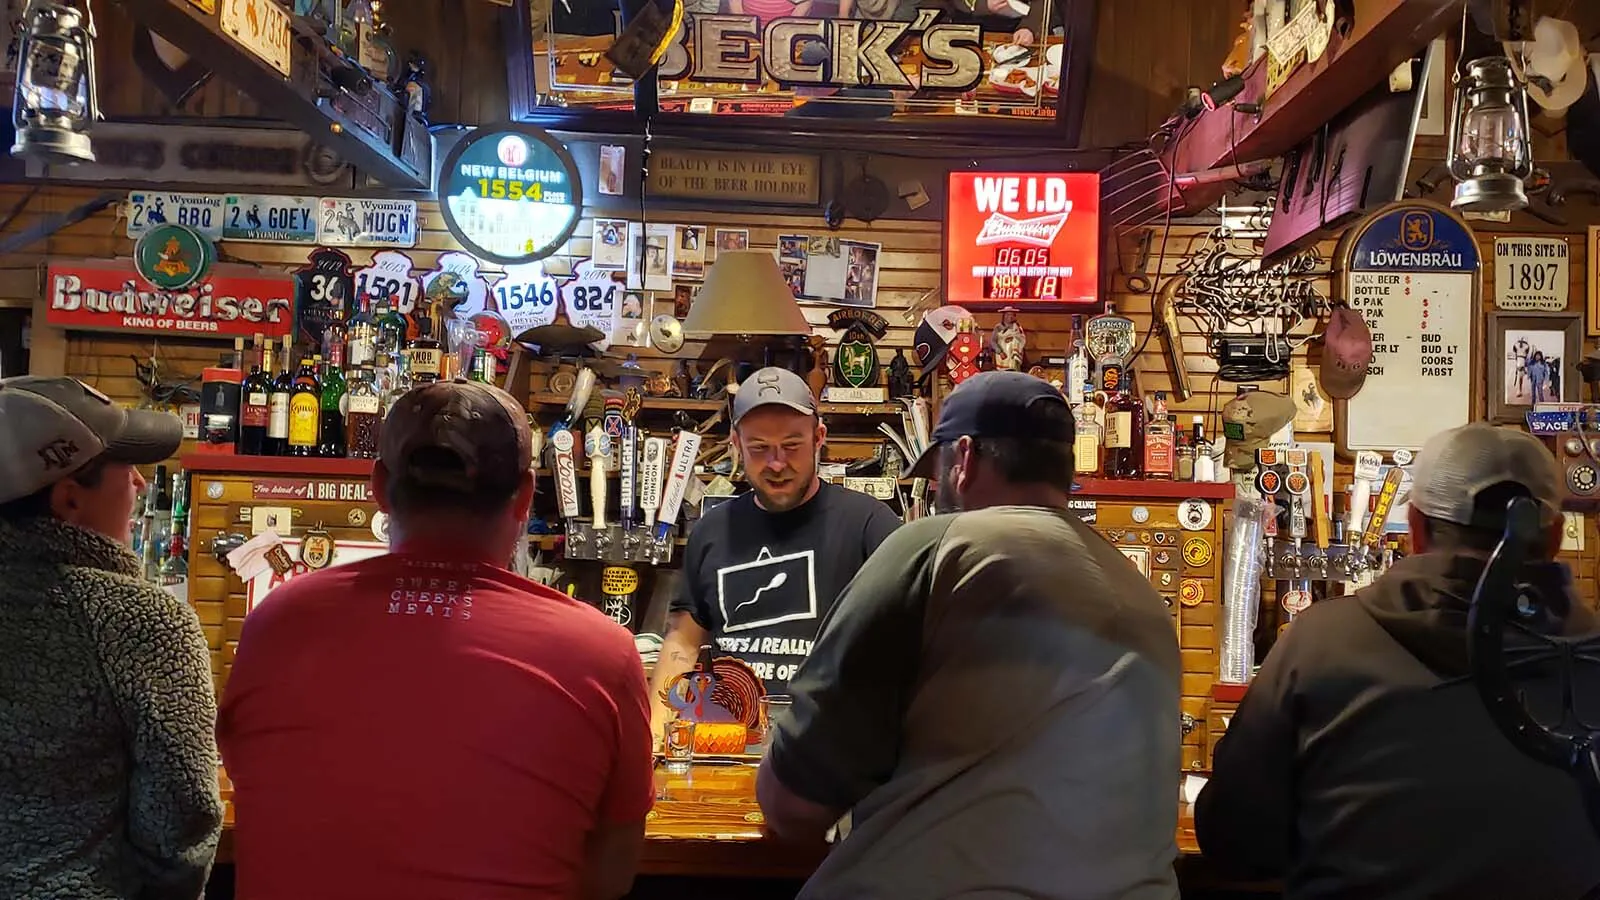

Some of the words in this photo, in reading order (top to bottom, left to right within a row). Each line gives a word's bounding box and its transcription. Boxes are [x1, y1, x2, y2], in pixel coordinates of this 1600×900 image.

[460, 164, 496, 178] NEW
[498, 166, 561, 183] BELGIUM
[661, 156, 711, 171] BEAUTY
[718, 159, 728, 171] IS
[733, 159, 746, 173] IN
[752, 161, 775, 174] THE
[782, 162, 807, 176] EYE
[478, 178, 542, 202] 1554
[659, 175, 675, 188] OF
[685, 176, 706, 189] THE
[714, 178, 748, 192] BEER
[754, 179, 807, 195] HOLDER
[169, 195, 220, 207] Wyoming
[973, 176, 1020, 213] WE
[1026, 176, 1073, 213] I.D.
[360, 200, 412, 214] Wyoming
[133, 204, 143, 227] 2
[178, 207, 211, 228] BBQ
[231, 206, 240, 228] 2
[268, 207, 310, 231] GOEY
[324, 209, 336, 233] 2
[362, 212, 409, 234] MUGN
[247, 230, 290, 241] WYOMING
[1370, 249, 1462, 267] LÖWENBRÄU
[1497, 243, 1509, 257] ON
[1511, 243, 1532, 257] THIS
[1534, 244, 1555, 257] SITE
[1557, 244, 1566, 258] IN
[379, 259, 407, 273] 2013
[583, 271, 607, 280] 2016
[993, 275, 1021, 288] NOV
[1355, 275, 1374, 284] CAN
[1377, 275, 1400, 285] BEER
[1508, 263, 1559, 291] 1897
[990, 287, 1021, 298] 2002
[1034, 276, 1057, 297] 18
[1354, 286, 1391, 296] BOTTLE
[51, 273, 290, 323] Budweiser
[497, 281, 554, 311] 1546
[573, 285, 616, 311] 824
[1353, 297, 1360, 306] 6
[1363, 297, 1384, 306] PAK
[1366, 309, 1384, 318] PAK
[123, 315, 155, 328] KING
[156, 317, 174, 329] OF
[175, 319, 218, 331] BEERS
[1421, 334, 1441, 343] BUD
[410, 351, 432, 360] KNOB
[1389, 345, 1400, 353] LT
[1421, 345, 1442, 354] BUD
[1447, 345, 1458, 354] LT
[1421, 356, 1453, 366] COORS
[1421, 367, 1454, 376] PABST
[1532, 421, 1568, 431] SPACE
[677, 438, 695, 473] ULTRA
[271, 484, 293, 494] kind
[306, 482, 314, 499] A
[317, 482, 337, 500] BIG
[339, 483, 368, 501] DEAL
[642, 463, 651, 506] JEREMIAH
[650, 463, 658, 506] JOHNSON
[390, 590, 473, 607] CHEEKS
[387, 602, 472, 620] MEATS
[749, 638, 761, 653] A
[761, 637, 815, 657] REALLY
[776, 664, 799, 681] OF
